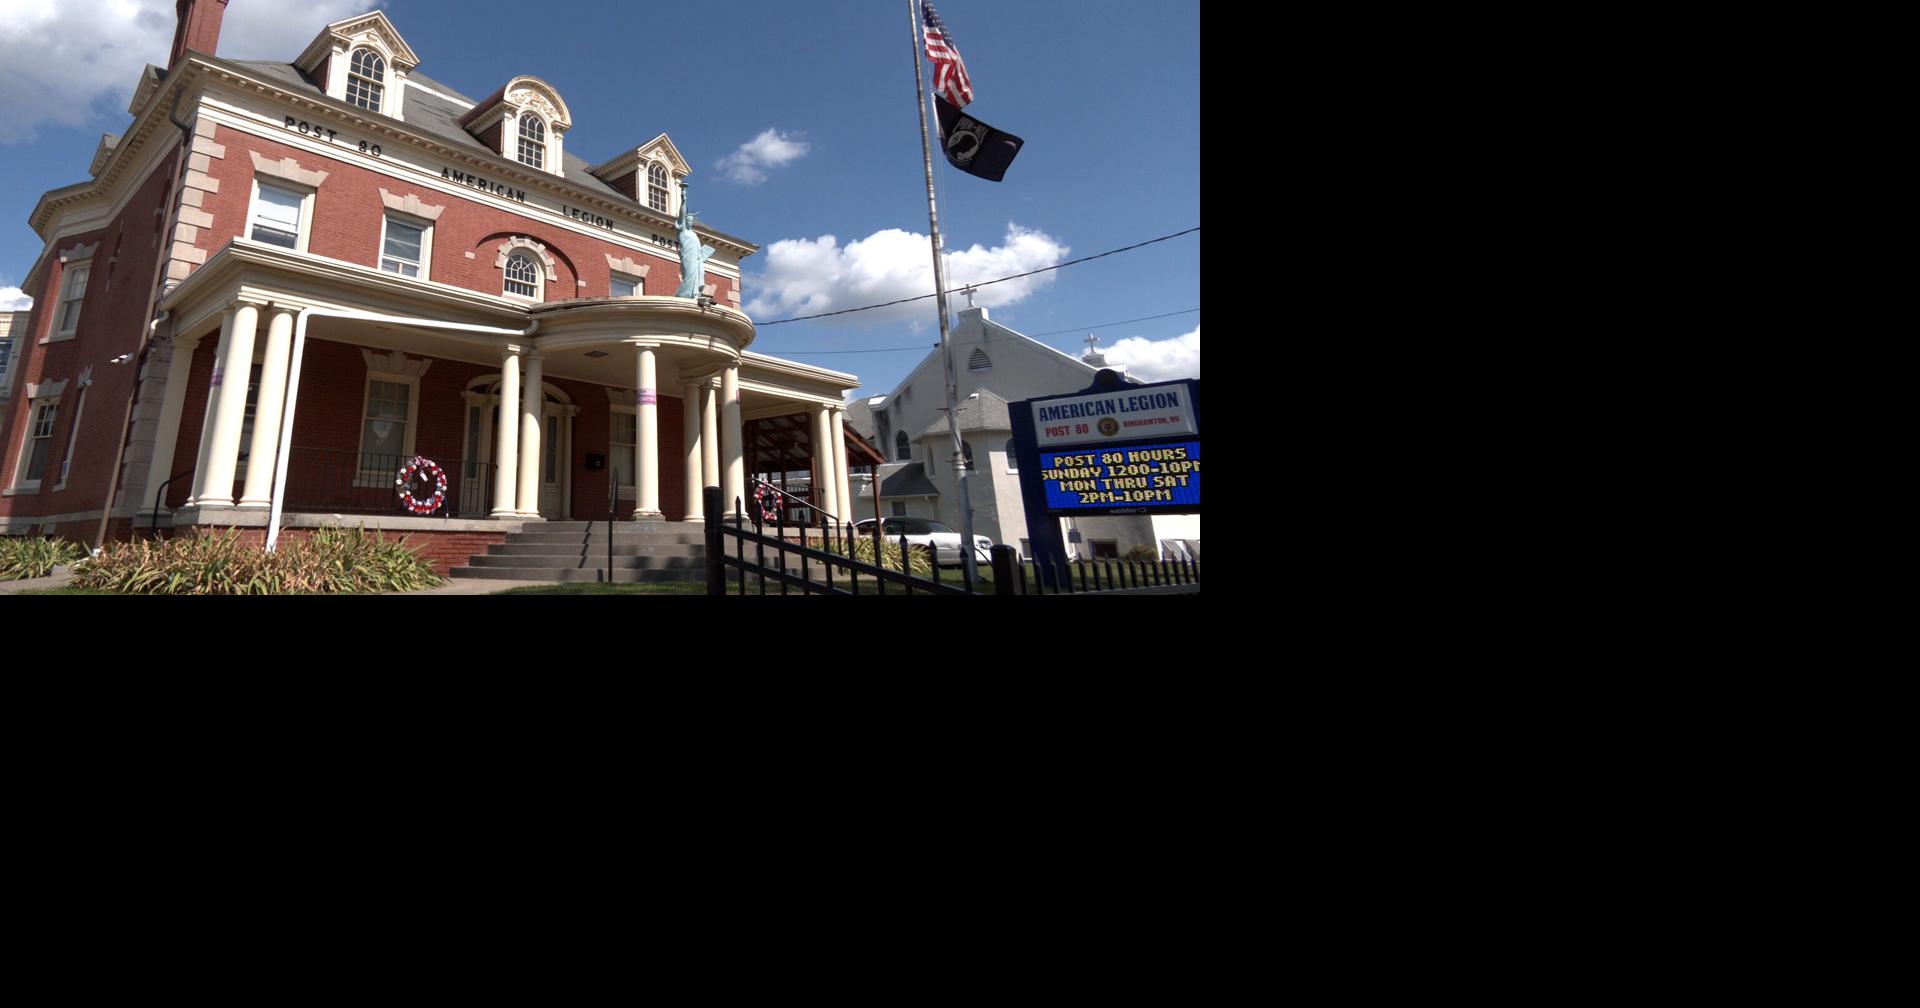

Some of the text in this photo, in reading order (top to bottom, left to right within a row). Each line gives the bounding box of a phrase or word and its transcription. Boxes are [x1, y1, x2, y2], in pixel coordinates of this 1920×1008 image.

[285, 115, 679, 251] POST 80 AMERICAN LEGION POST
[1039, 391, 1179, 422] AMERICAN LEGION
[1045, 423, 1089, 438] POST 80
[1054, 448, 1187, 467] POST 80 HOURS
[1041, 467, 1102, 481] SUNDAY
[1059, 474, 1189, 492] MON THRU SAT
[1079, 489, 1173, 504] 2PM-10PM
